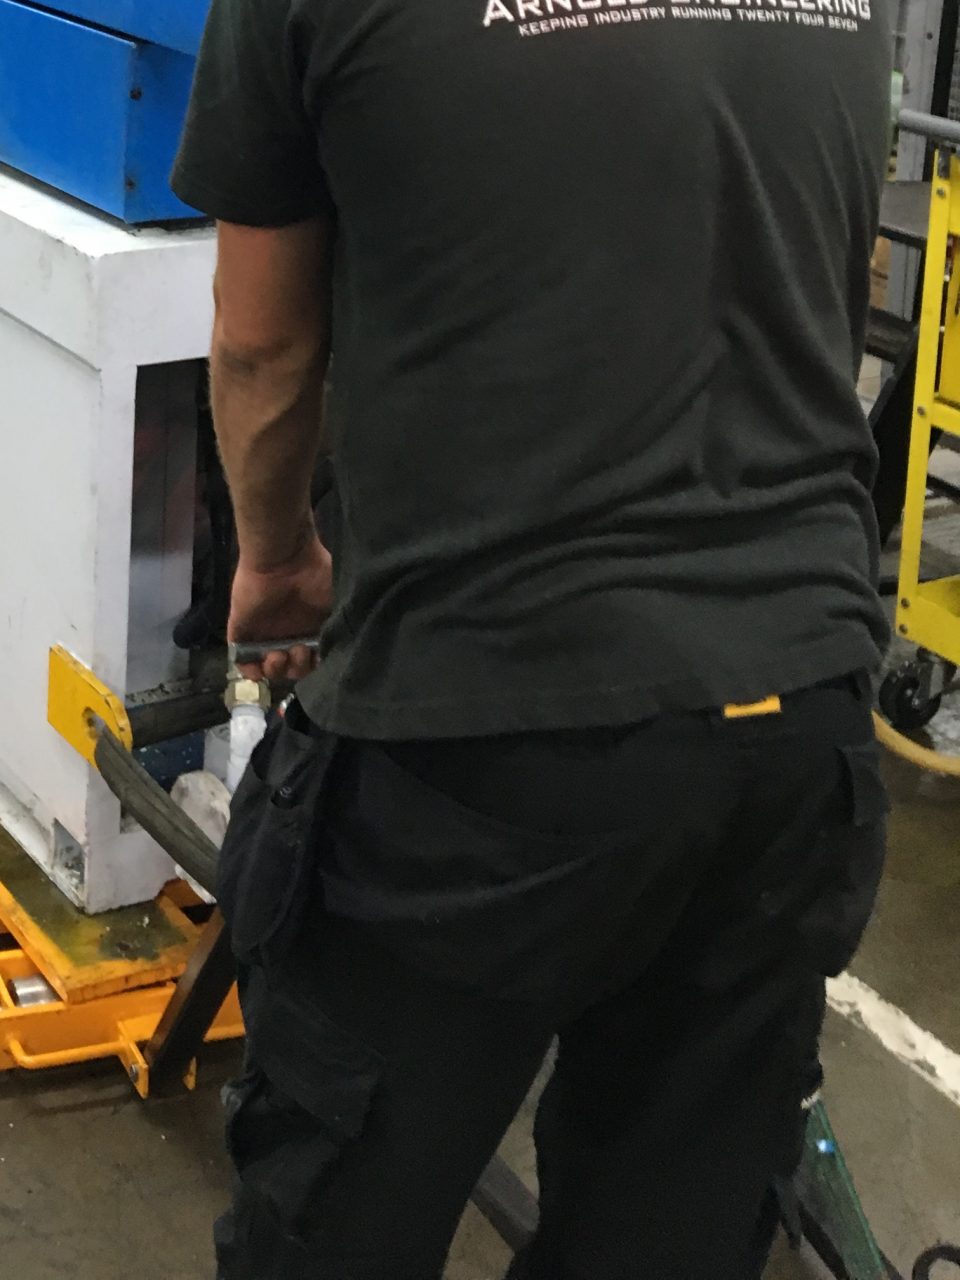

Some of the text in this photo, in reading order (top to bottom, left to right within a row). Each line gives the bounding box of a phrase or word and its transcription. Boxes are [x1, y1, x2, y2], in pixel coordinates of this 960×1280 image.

[518, 6, 858, 37] KEEPING INDUSTRY RUNNING TWENTY FOUR SEVEN
